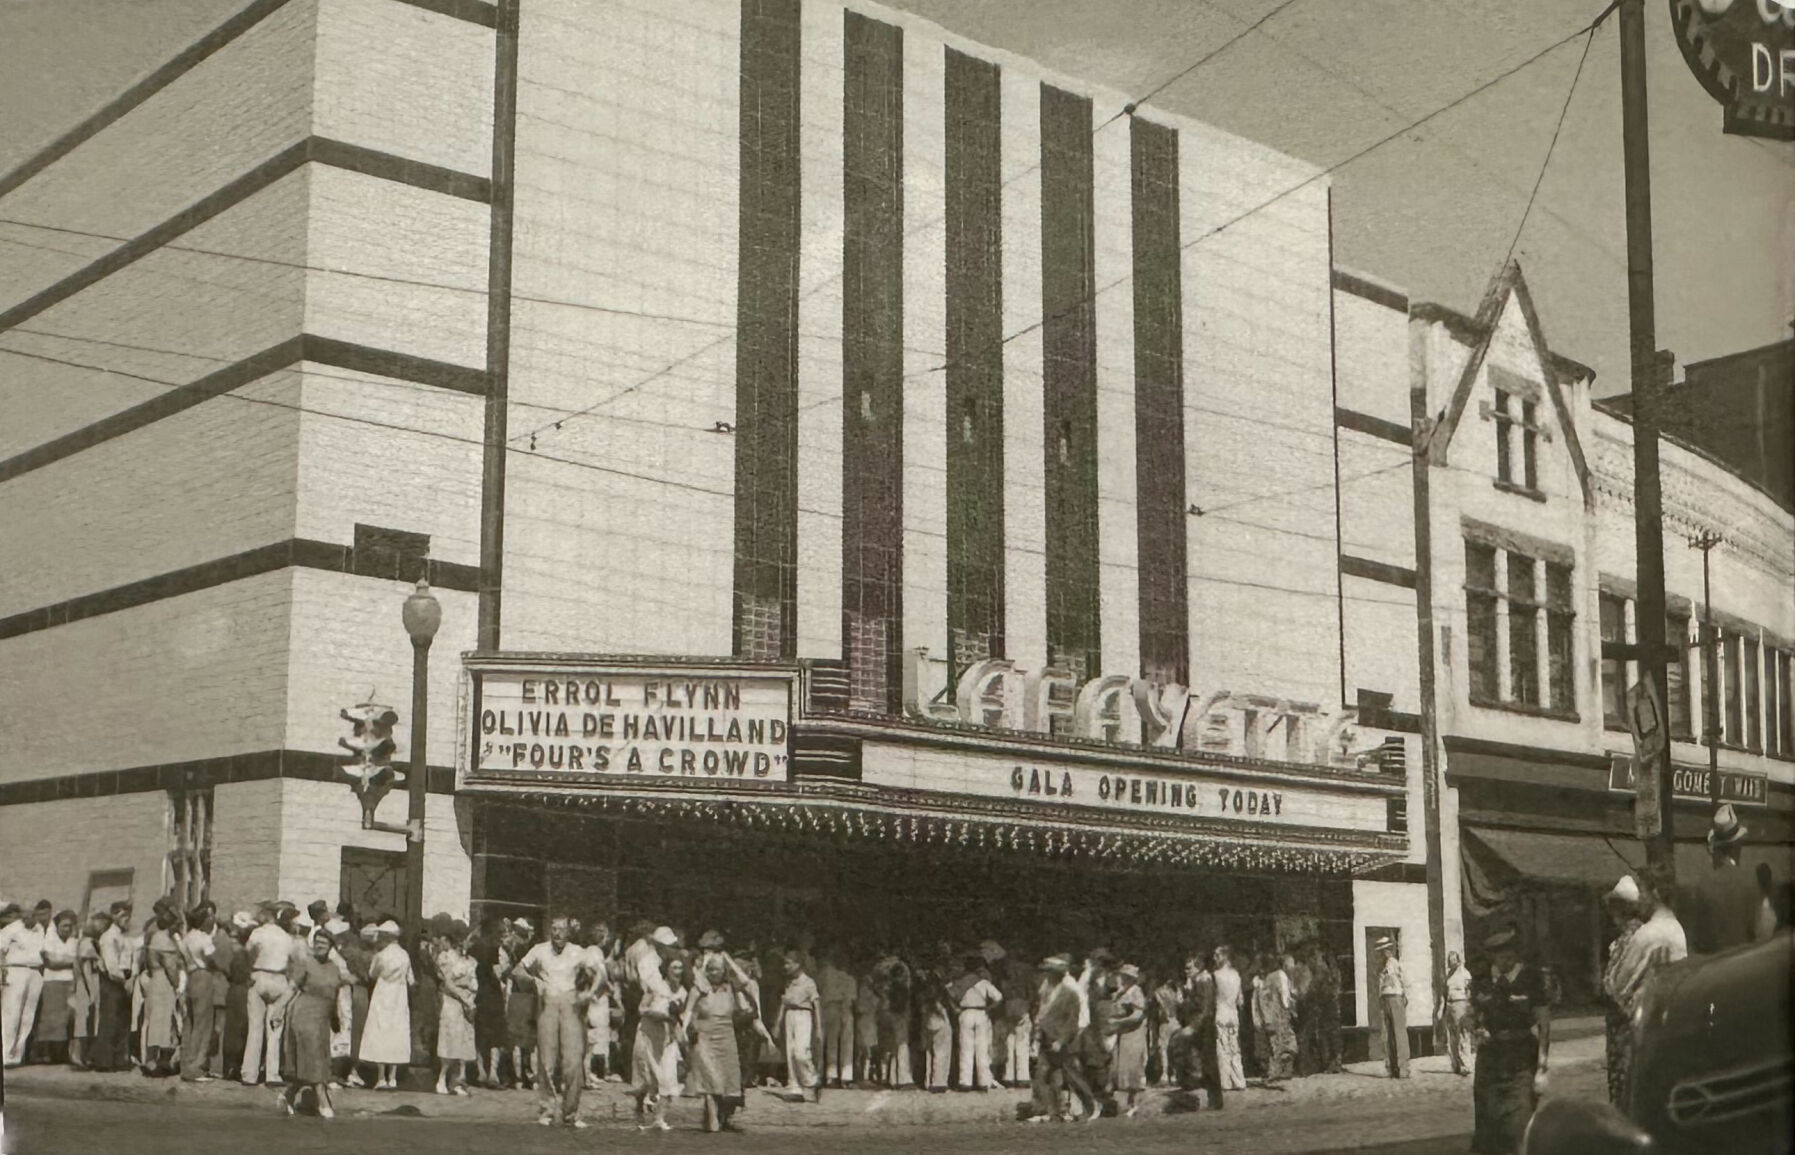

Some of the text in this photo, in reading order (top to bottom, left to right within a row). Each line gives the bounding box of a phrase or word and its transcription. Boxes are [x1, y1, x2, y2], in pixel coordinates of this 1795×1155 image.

[522, 680, 740, 710] ERROL FLYNN
[482, 709, 786, 745] OLIVIA DE HAVILLAND
[627, 750, 644, 772] A
[1010, 766, 1283, 816] GALA OPENING TODAY
